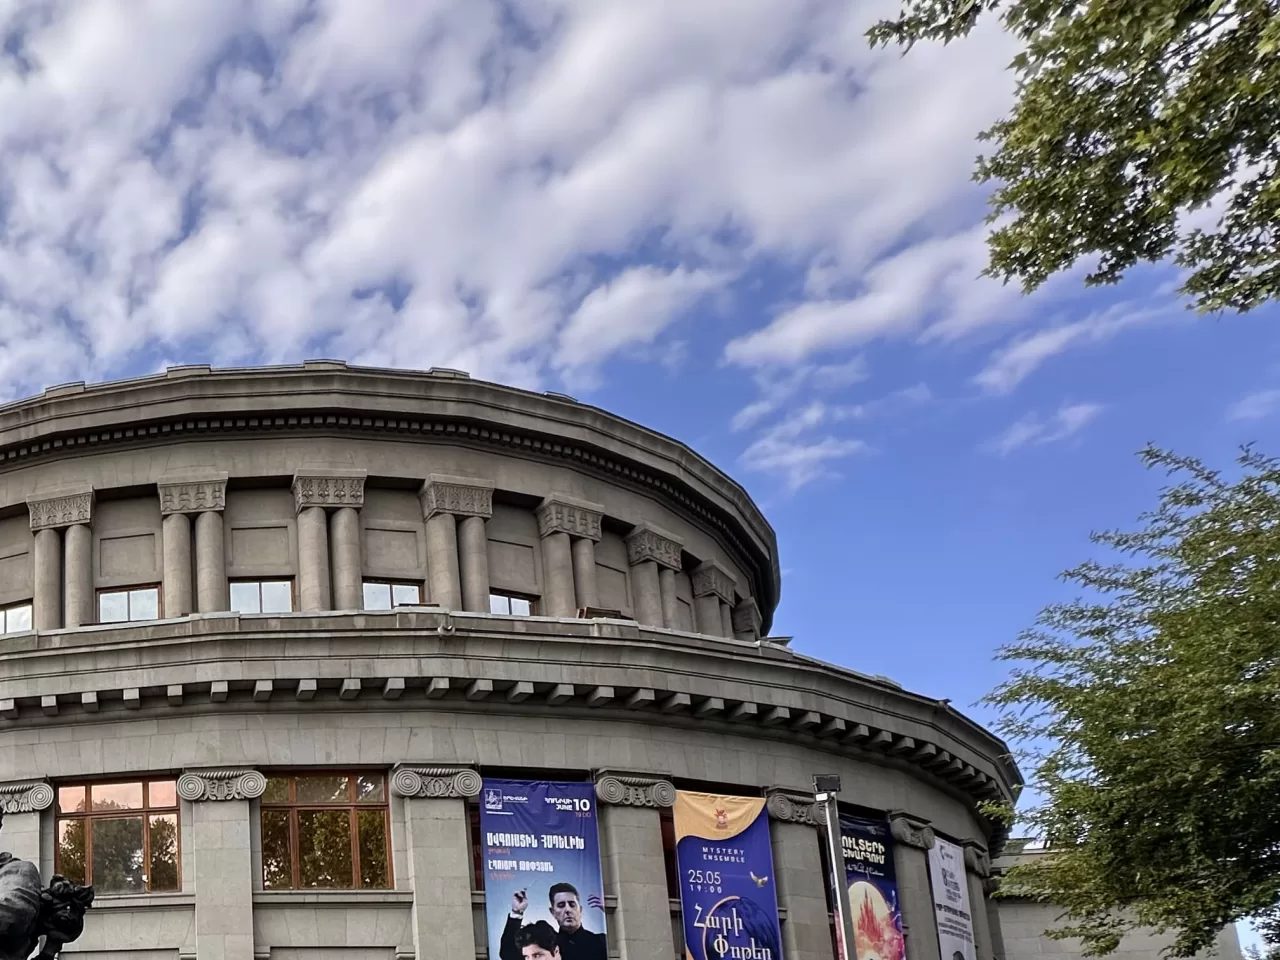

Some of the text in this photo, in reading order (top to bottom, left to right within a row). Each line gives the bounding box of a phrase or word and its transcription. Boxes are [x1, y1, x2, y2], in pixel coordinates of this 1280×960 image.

[573, 798, 590, 811] 10
[486, 832, 584, 850] ԱՎԳՈՒՍՏԻՆ ՀԱԴԵԼԻԽ
[841, 835, 885, 854] ՈՒԼՏԵՐԻ
[702, 846, 744, 855] MYSTERY
[703, 854, 745, 863] ENSEMBLE
[841, 847, 885, 864] ՇԽԱՐՀՈՒՄ
[688, 869, 721, 885] 25.05
[689, 884, 722, 894] 19:00
[693, 903, 744, 936] Հարի
